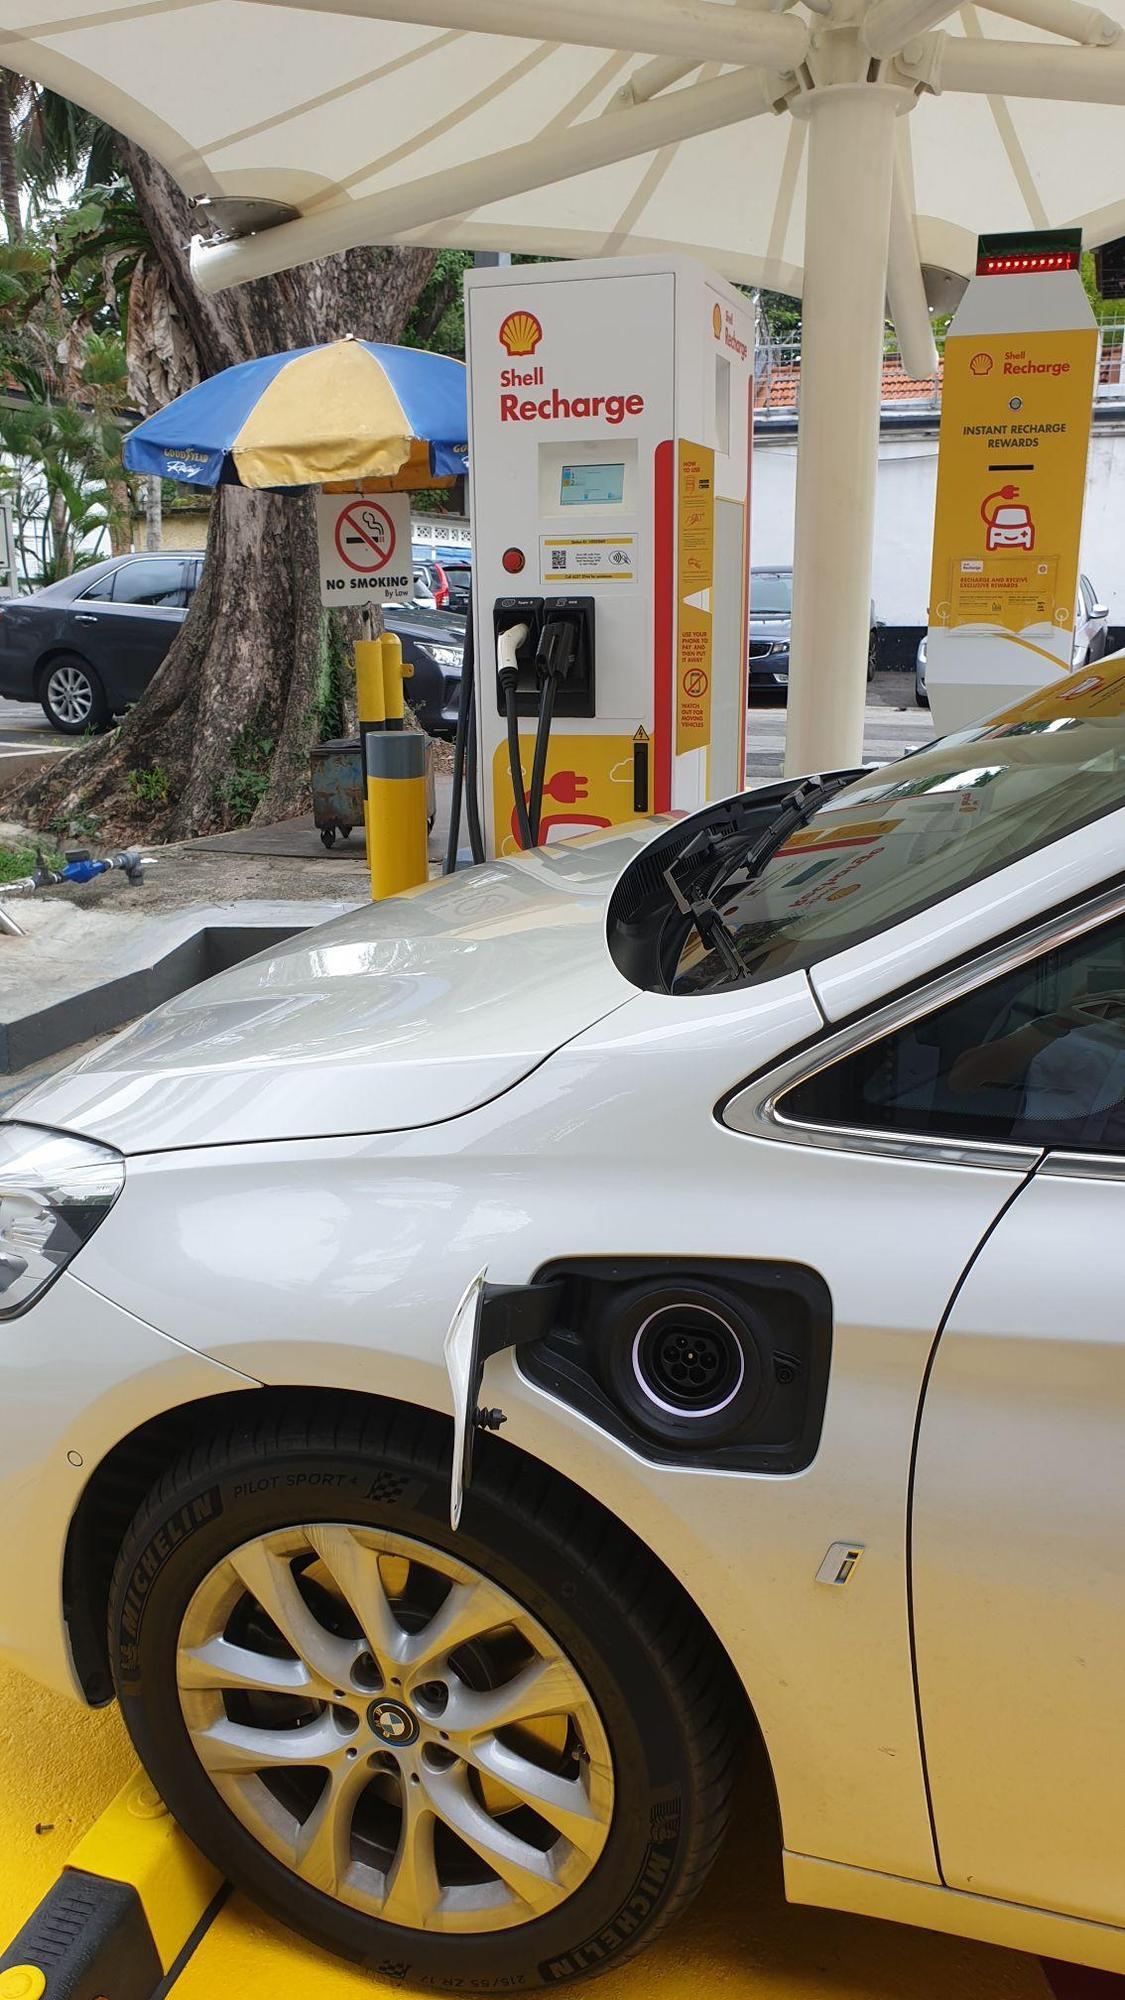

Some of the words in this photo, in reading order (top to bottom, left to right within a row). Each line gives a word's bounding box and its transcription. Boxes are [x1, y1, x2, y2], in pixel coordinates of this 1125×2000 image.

[1004, 351, 1026, 360] Shell
[1003, 360, 1070, 376] Recharge
[500, 366, 544, 387] Shell
[500, 388, 645, 425] Recharge
[963, 425, 1008, 436] INSTANT
[1010, 423, 1067, 434] RECHARGE
[987, 438, 1039, 448] REWARDS
[326, 579, 345, 590] NO
[350, 576, 409, 589] SMOKING
[384, 590, 394, 599] By
[395, 589, 409, 597] Law
[233, 1475, 280, 1498] PILOT
[286, 1472, 346, 1487] SPORT
[121, 1489, 216, 1638] MICHELIN
[547, 1850, 674, 1980] MICHELIN
